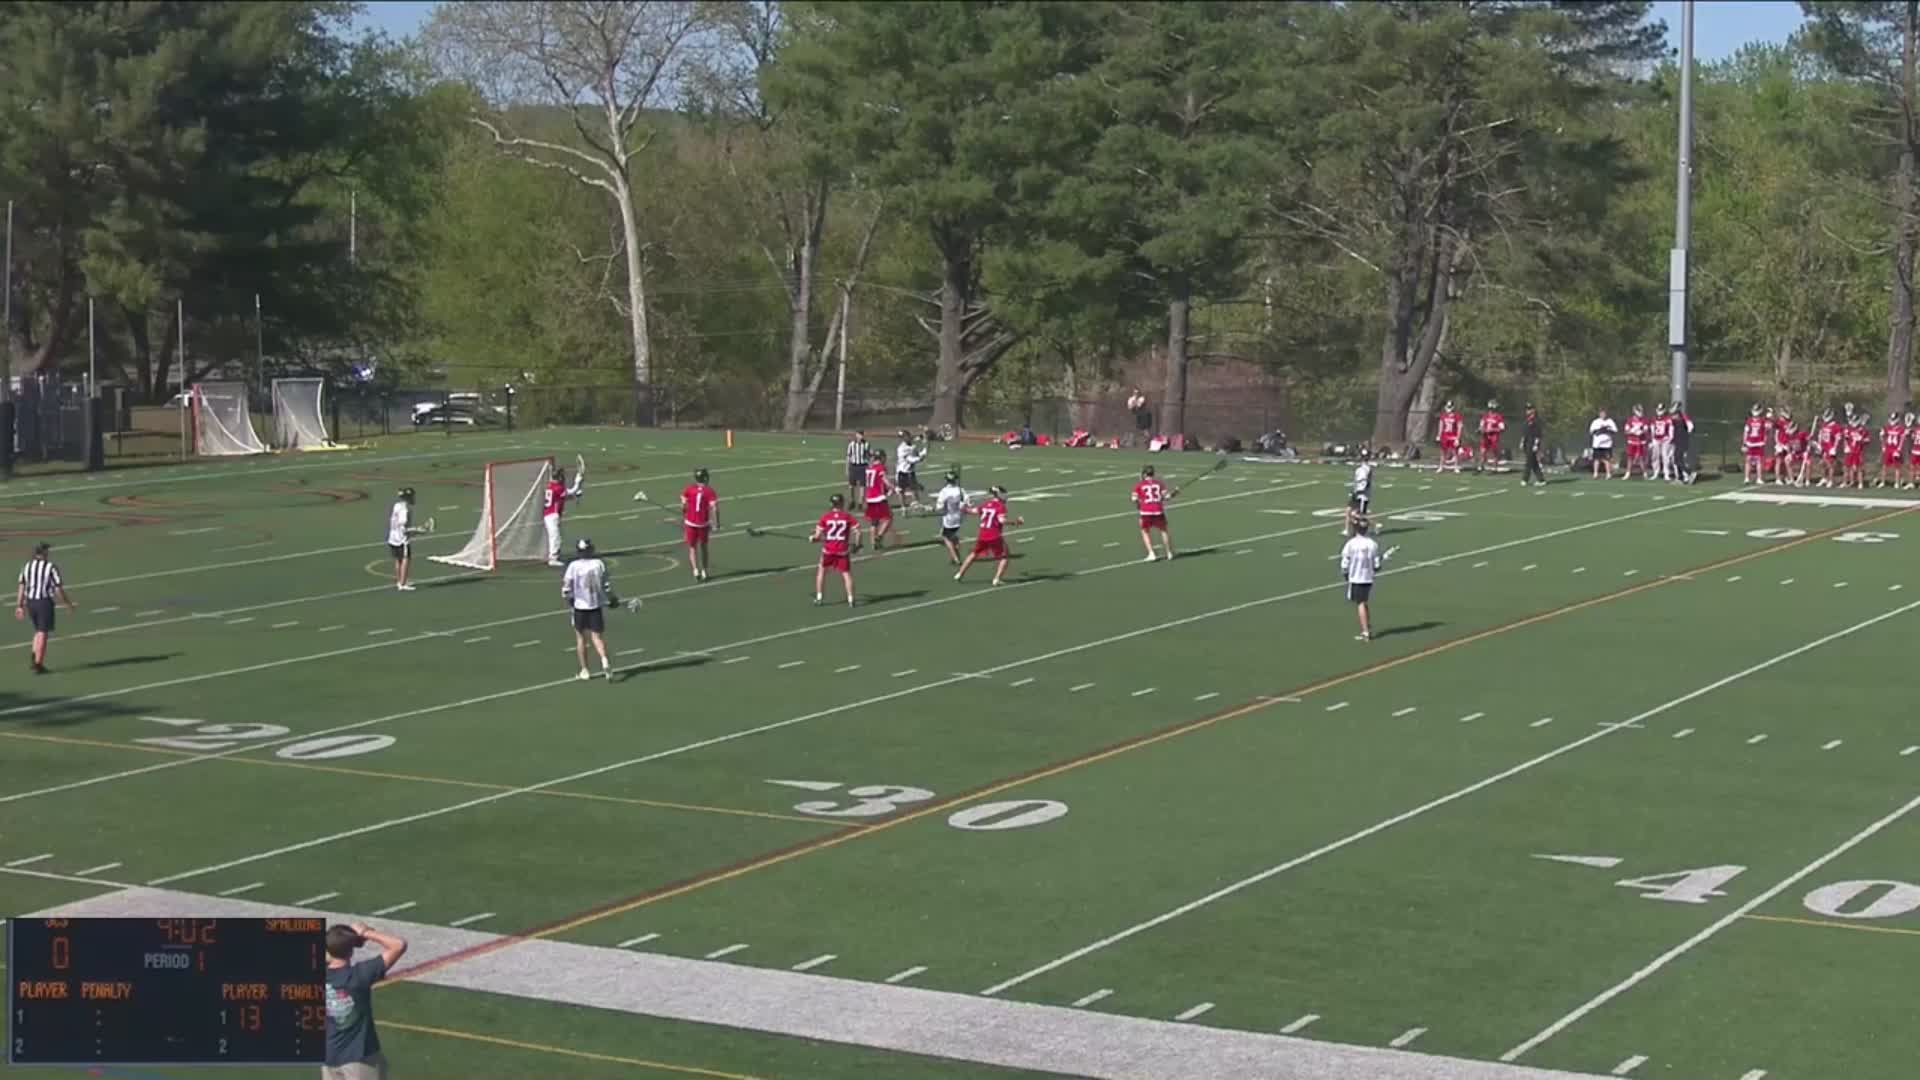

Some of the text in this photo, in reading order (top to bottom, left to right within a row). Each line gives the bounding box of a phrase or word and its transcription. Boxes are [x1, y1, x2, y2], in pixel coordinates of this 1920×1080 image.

[696, 492, 703, 512] 1
[1141, 484, 1162, 503] 33
[826, 519, 848, 541] 22
